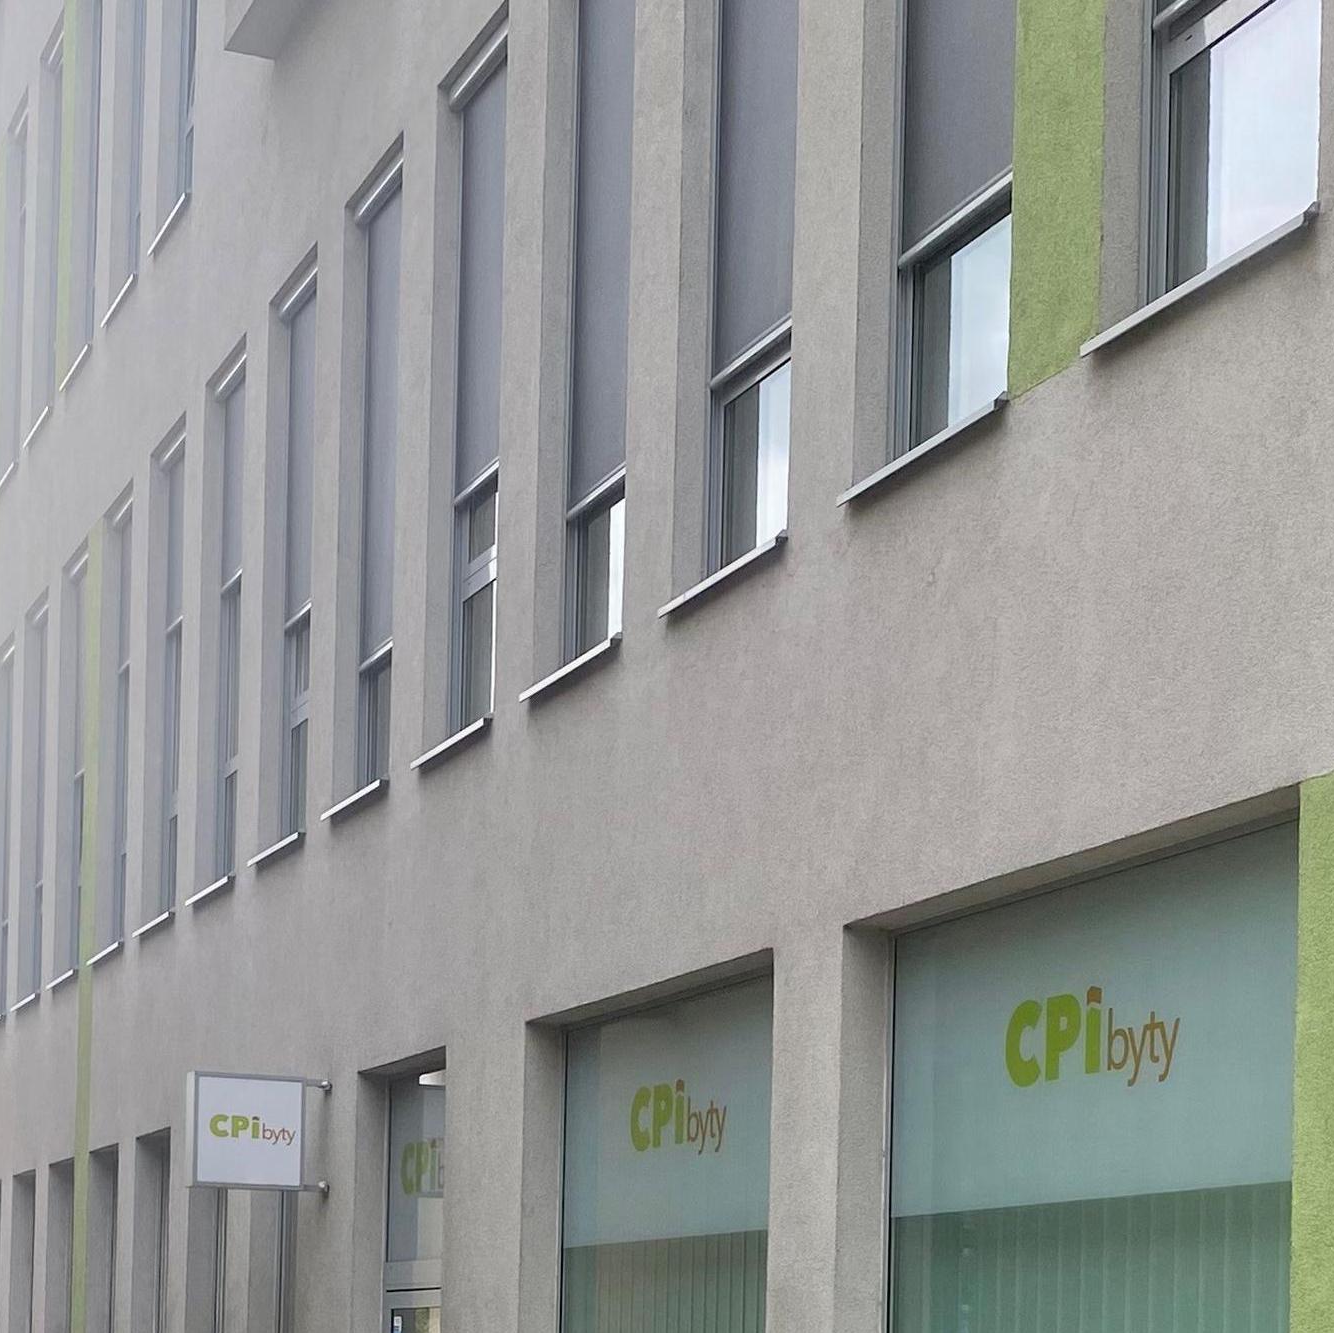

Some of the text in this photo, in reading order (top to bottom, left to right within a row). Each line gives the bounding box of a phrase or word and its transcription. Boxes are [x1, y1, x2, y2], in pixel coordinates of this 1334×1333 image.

[1107, 1007, 1180, 1087] byty
[262, 1122, 296, 1146] byty
[686, 1096, 727, 1155] byty
